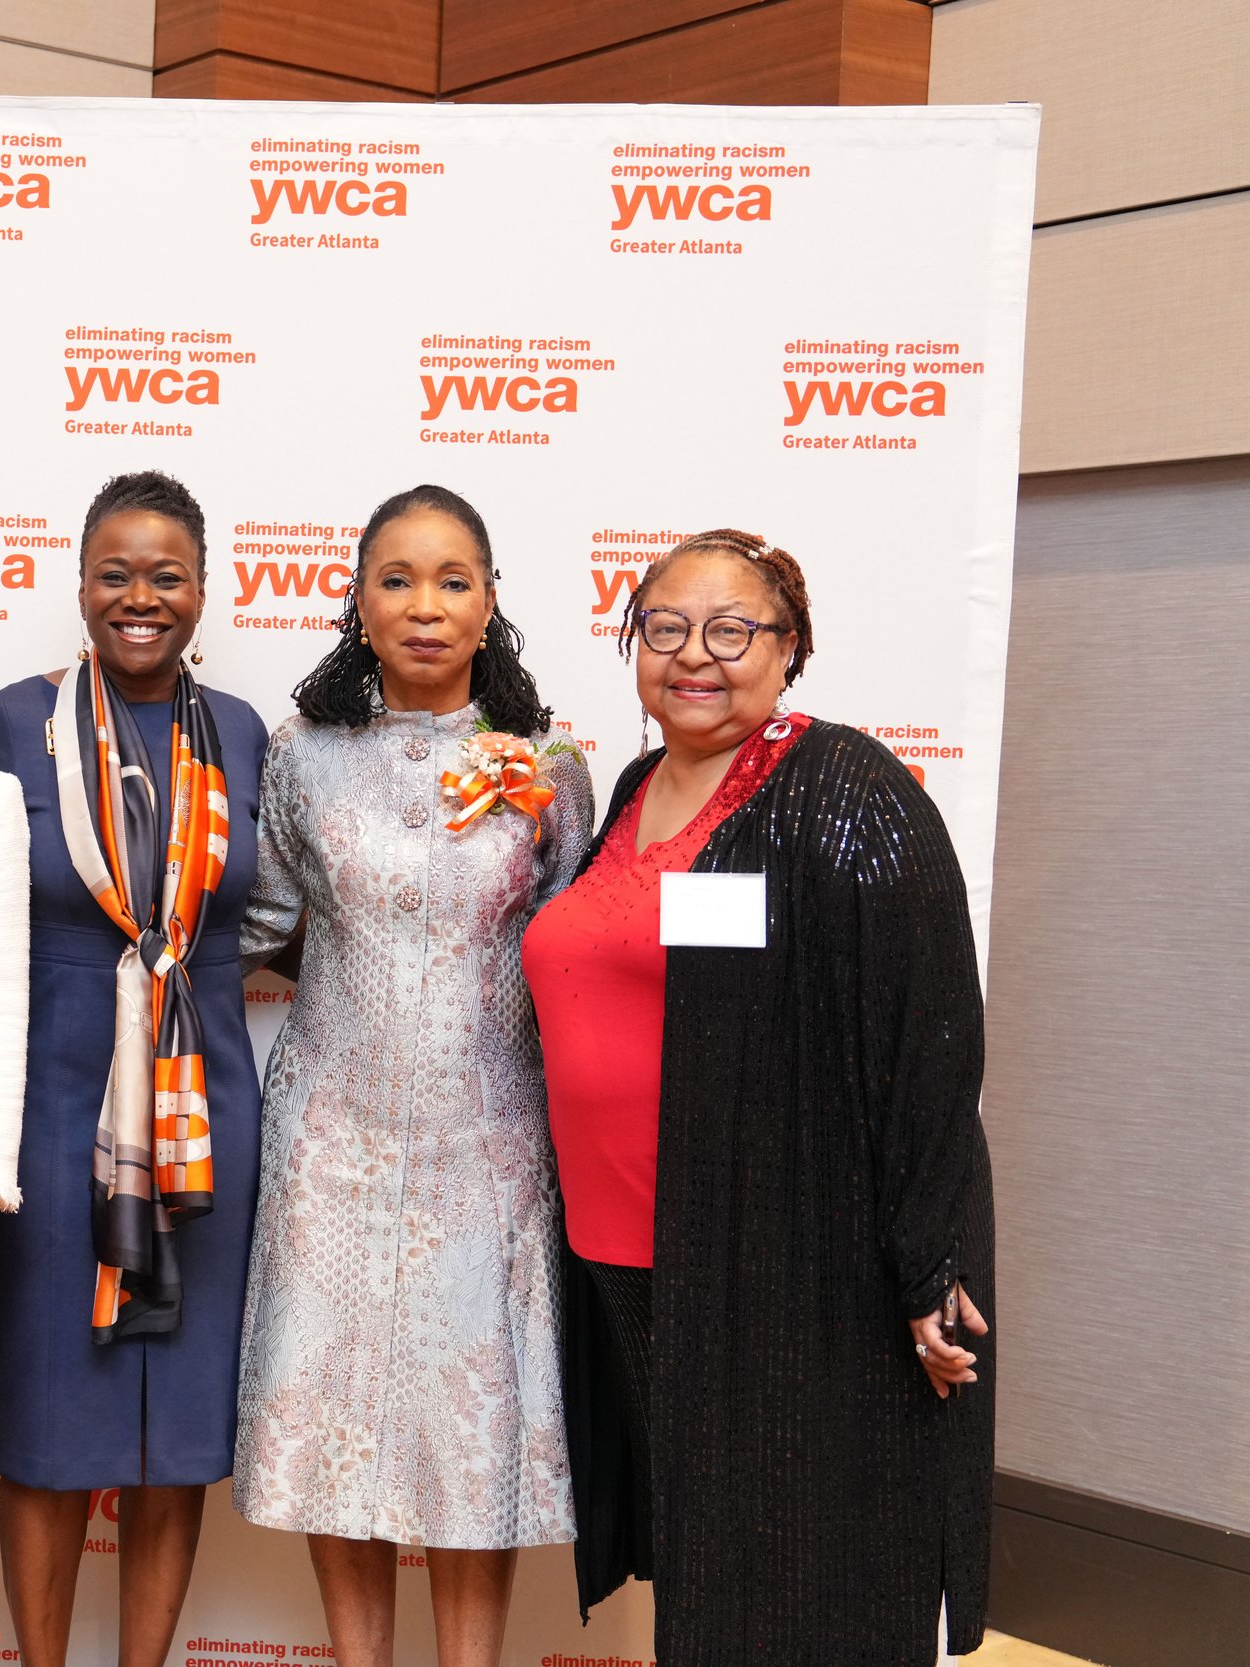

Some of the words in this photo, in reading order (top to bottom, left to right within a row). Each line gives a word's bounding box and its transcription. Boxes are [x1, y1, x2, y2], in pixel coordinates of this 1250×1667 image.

[1, 134, 63, 148] racism
[250, 138, 352, 157] eliminating
[358, 142, 421, 156] racism
[17, 154, 87, 168] women
[613, 143, 716, 162] eliminating
[722, 144, 786, 159] racism
[249, 158, 368, 177] empowering
[374, 162, 445, 175] women
[611, 162, 732, 182] empowering
[739, 165, 811, 179] women
[250, 179, 407, 224] ywca
[611, 184, 772, 230] ywca
[250, 232, 314, 249] Greater
[317, 233, 379, 250] Atlanta
[610, 238, 676, 254] Greater
[680, 239, 742, 255] Atlanta
[65, 326, 165, 346] eliminating
[171, 329, 233, 345] racism
[421, 333, 522, 353] eliminating
[528, 336, 591, 352] racism
[63, 348, 181, 367] empowering
[187, 351, 257, 365] women
[785, 339, 889, 358] eliminating
[895, 340, 960, 356] racism
[419, 356, 539, 375] empowering
[545, 358, 616, 372] women
[783, 359, 906, 378] empowering
[912, 361, 985, 375] women
[65, 366, 220, 412] ywca
[420, 375, 578, 421] ywca
[783, 381, 946, 426] ywca
[65, 419, 128, 436] Greater
[131, 420, 193, 437] Atlanta
[420, 427, 484, 444] Greater
[488, 429, 550, 446] Atlanta
[783, 433, 849, 450] Greater
[853, 434, 917, 450] Atlanta
[234, 521, 335, 540] eliminating
[4, 534, 72, 549] women
[233, 541, 351, 560] empowering
[233, 561, 353, 606] ywc
[233, 614, 297, 630] Greater
[875, 724, 939, 739] racism
[892, 745, 964, 759] women
[245, 989, 280, 1003] ater
[83, 1538, 117, 1553] Atla
[186, 1637, 286, 1659] eliminating
[292, 1643, 335, 1658] racis
